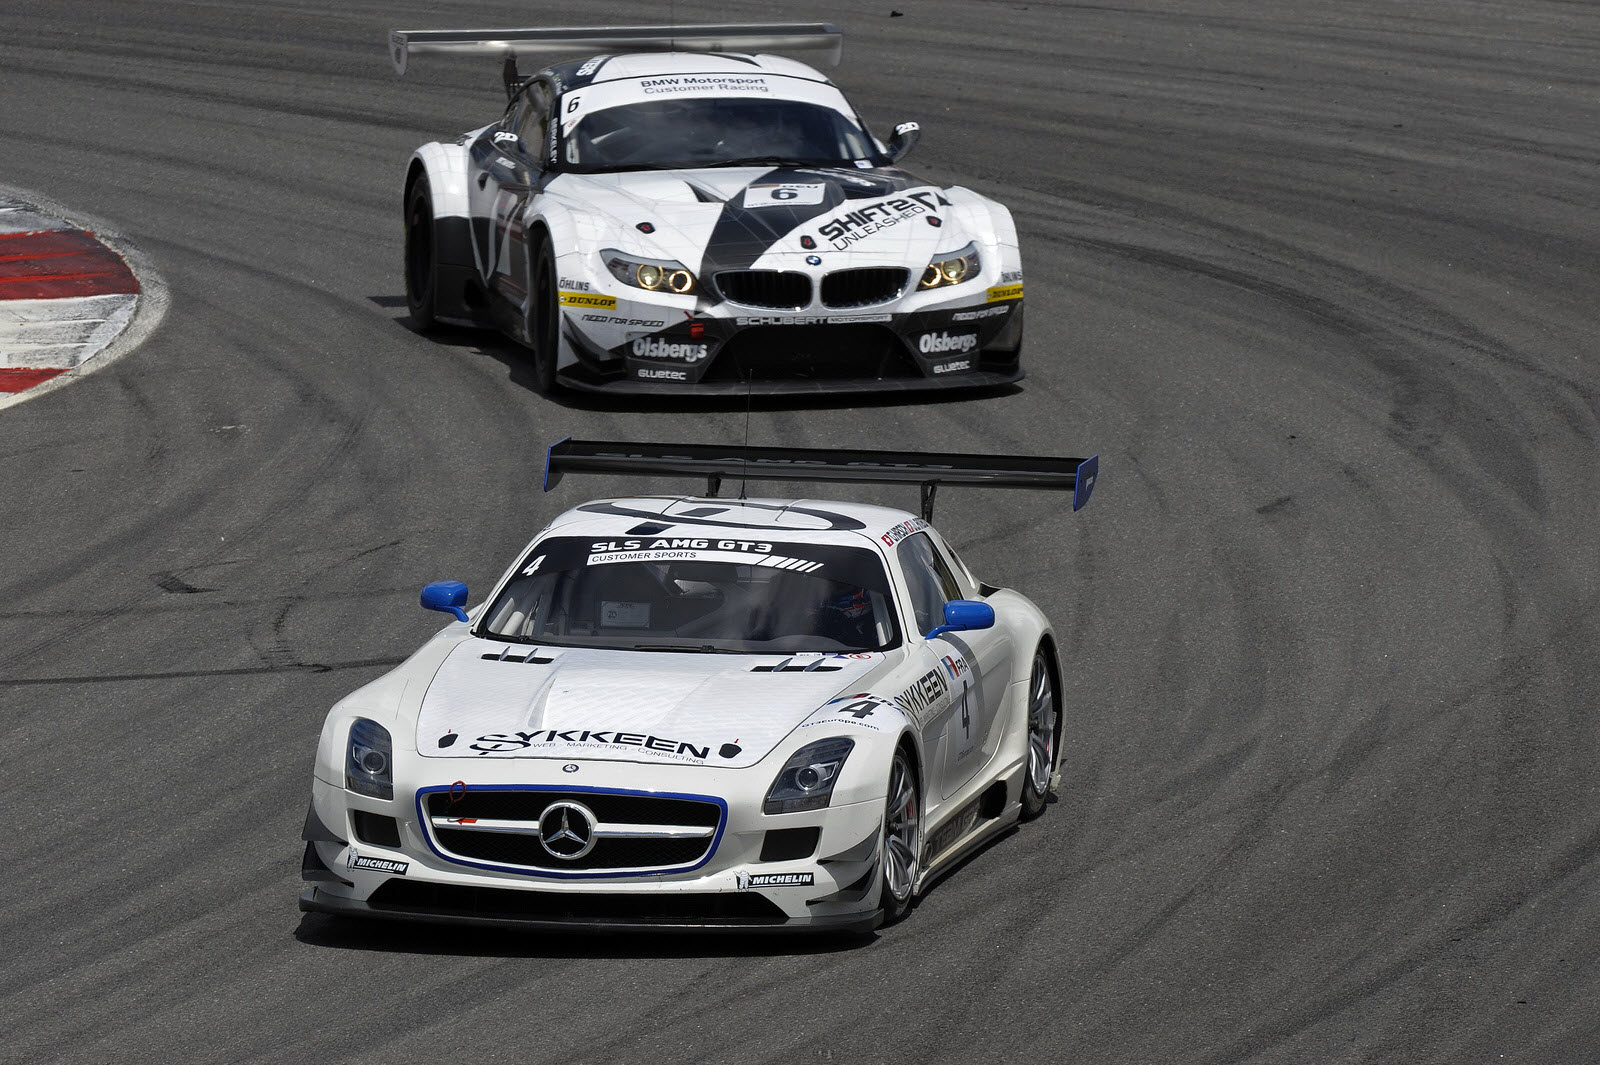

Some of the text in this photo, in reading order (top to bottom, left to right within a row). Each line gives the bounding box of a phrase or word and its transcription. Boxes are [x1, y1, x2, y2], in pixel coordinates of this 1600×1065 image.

[640, 77, 767, 88] BMW Motorsport
[643, 83, 769, 94] Customer Racing
[567, 96, 581, 113] 6
[770, 188, 799, 200] 6
[833, 206, 926, 251] UNLEASHED
[559, 276, 590, 291] ÖHLINS
[567, 296, 616, 307] DUNLOP
[581, 314, 666, 328] NEED FOR SPEED
[736, 316, 827, 326] SCHUBERT
[632, 337, 708, 362] Olsbergs
[590, 538, 773, 553] SLS AMG GT3
[592, 551, 697, 563] CUSTOMER SPORTS
[522, 554, 547, 577] 4
[955, 657, 970, 676] FRA
[893, 665, 948, 732] SYKKEEN
[837, 700, 881, 719] 4
[962, 680, 970, 739] 4
[469, 730, 711, 759] SYKKEEN
[566, 741, 628, 751] MARKETING
[637, 747, 705, 765] CONSULTING
[356, 857, 408, 872] MICHELIN
[752, 874, 812, 885] MICHELIN
